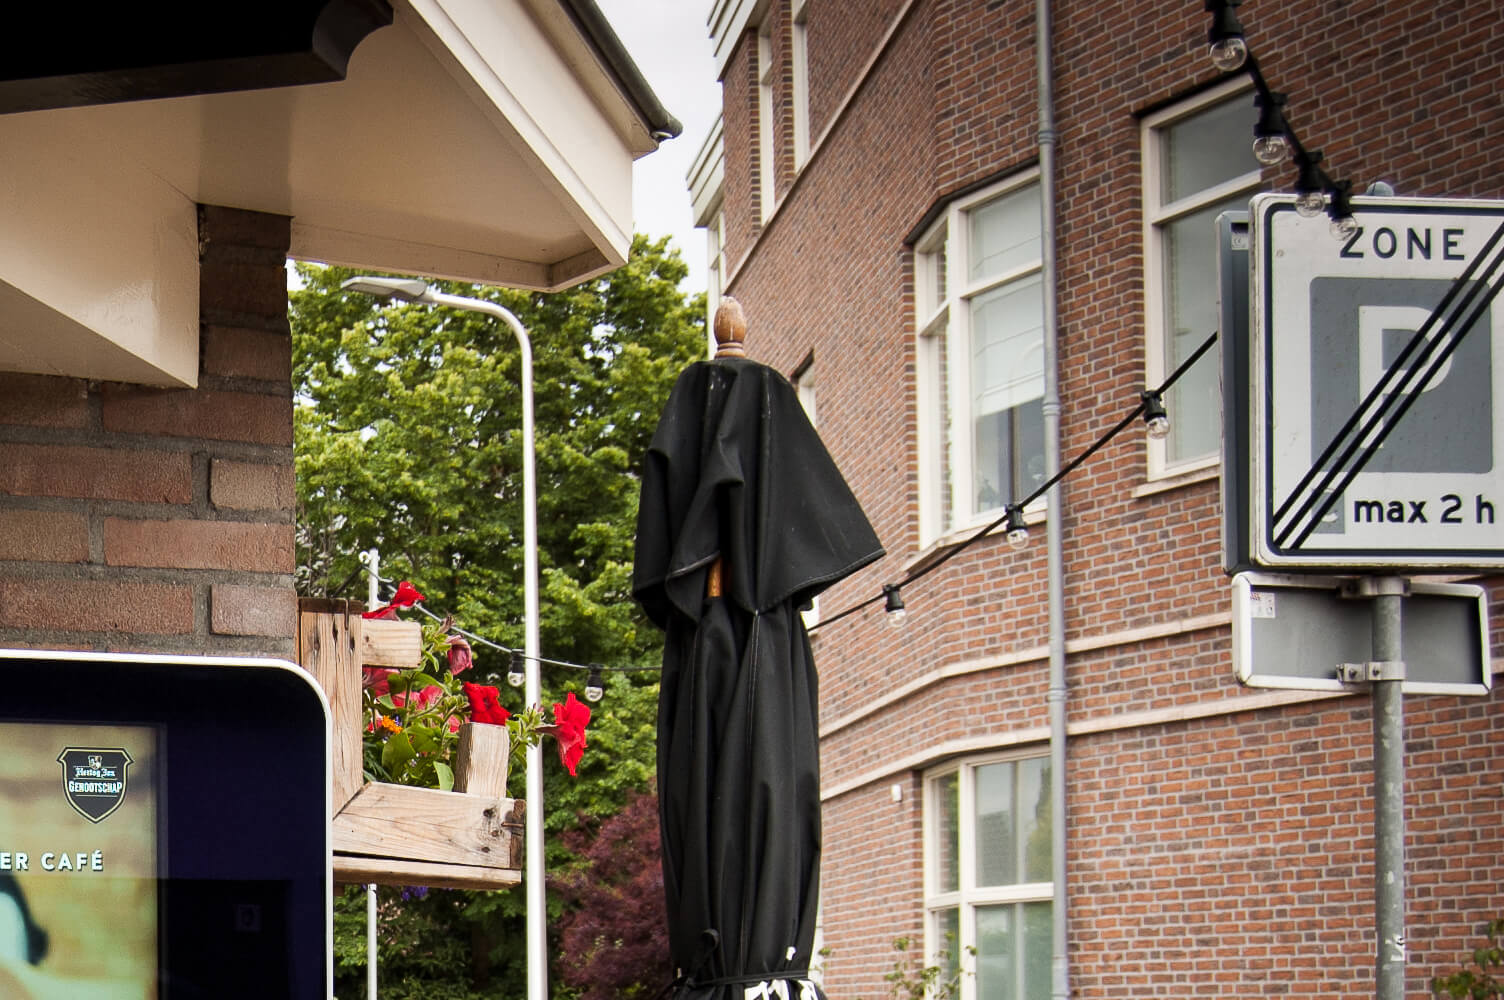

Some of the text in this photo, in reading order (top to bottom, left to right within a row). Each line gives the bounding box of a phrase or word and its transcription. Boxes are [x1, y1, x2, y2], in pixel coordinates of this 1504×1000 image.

[1339, 226, 1466, 261] ZONE
[1358, 305, 1453, 449] P
[1353, 493, 1495, 524] max 2 h
[68, 781, 123, 793] GENOOTSCHAP
[41, 850, 105, 872] CAFÉ
